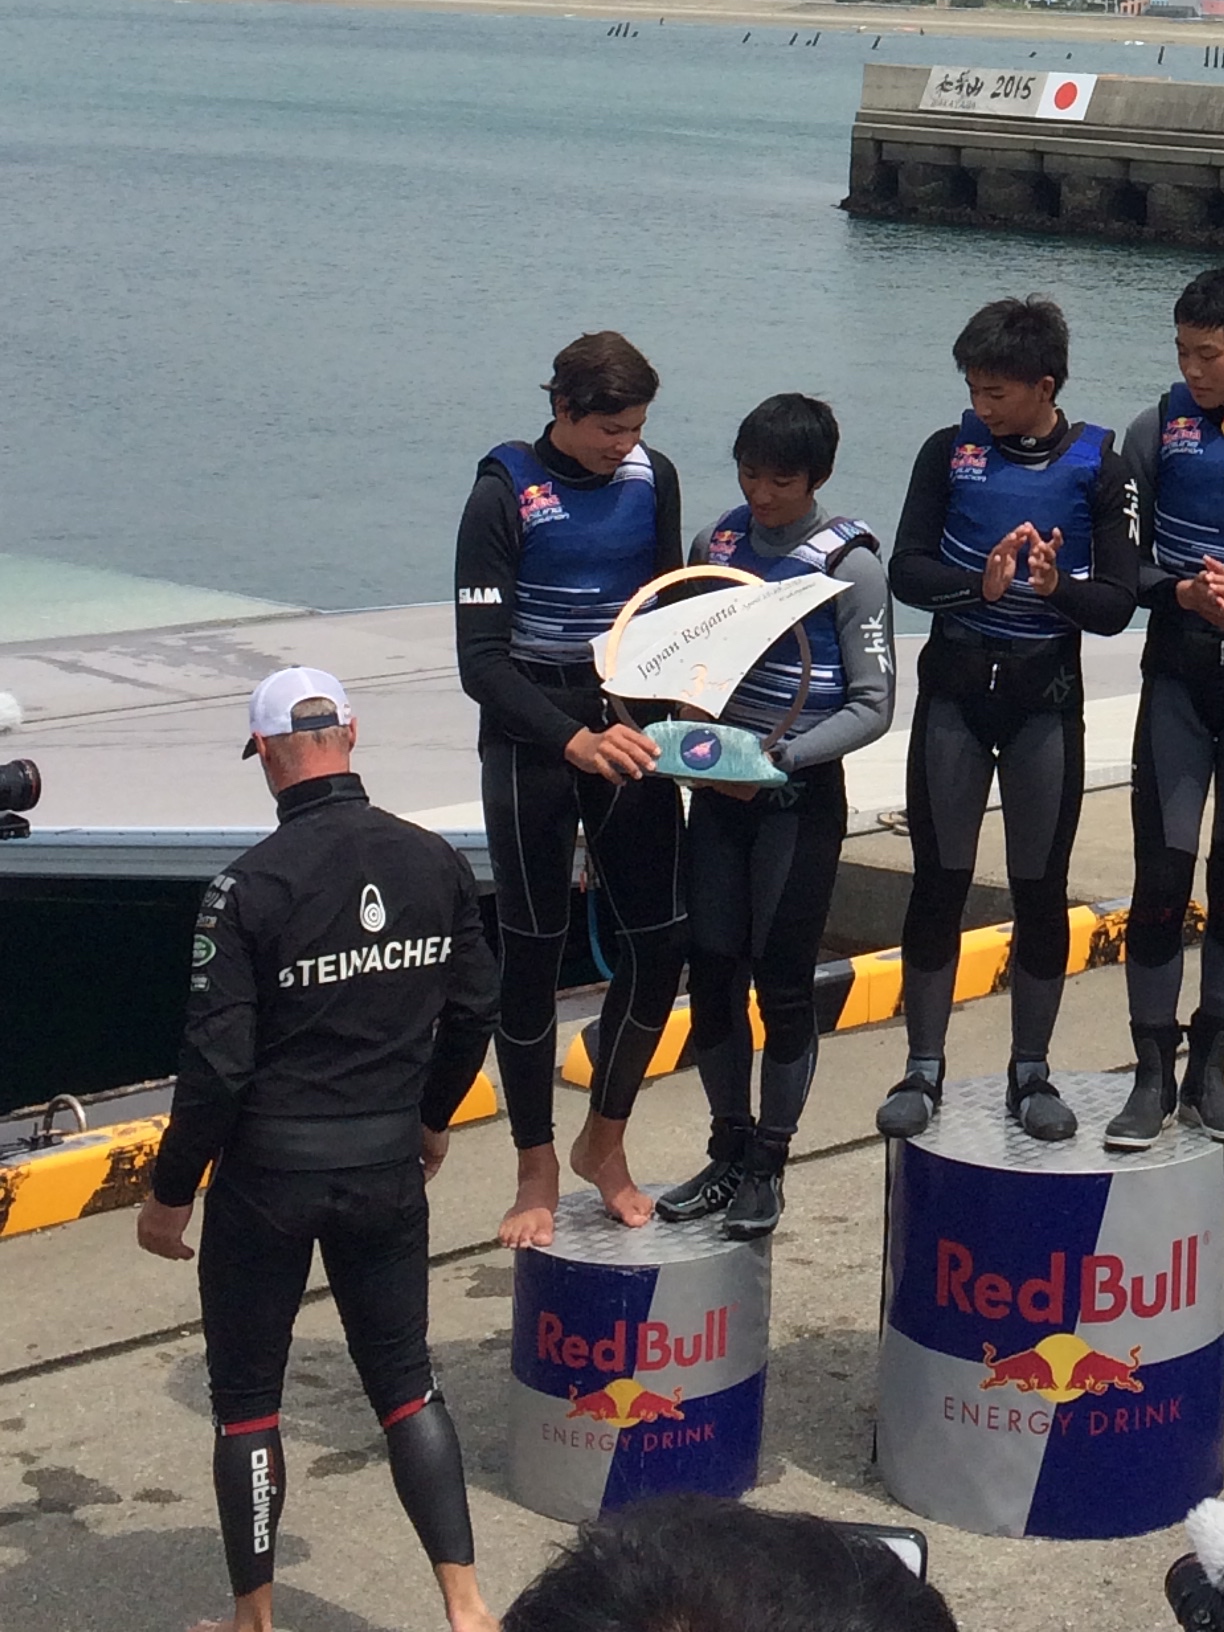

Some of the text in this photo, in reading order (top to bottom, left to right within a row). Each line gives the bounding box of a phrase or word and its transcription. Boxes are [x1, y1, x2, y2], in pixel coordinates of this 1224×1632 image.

[990, 75, 1036, 99] 2015
[637, 641, 680, 680] Japan
[936, 1235, 1199, 1324] Red Bull
[537, 1305, 728, 1371] Red Bull
[943, 1396, 1182, 1436] ENERGY DRINK
[542, 1423, 715, 1452] ENERGY DRINK
